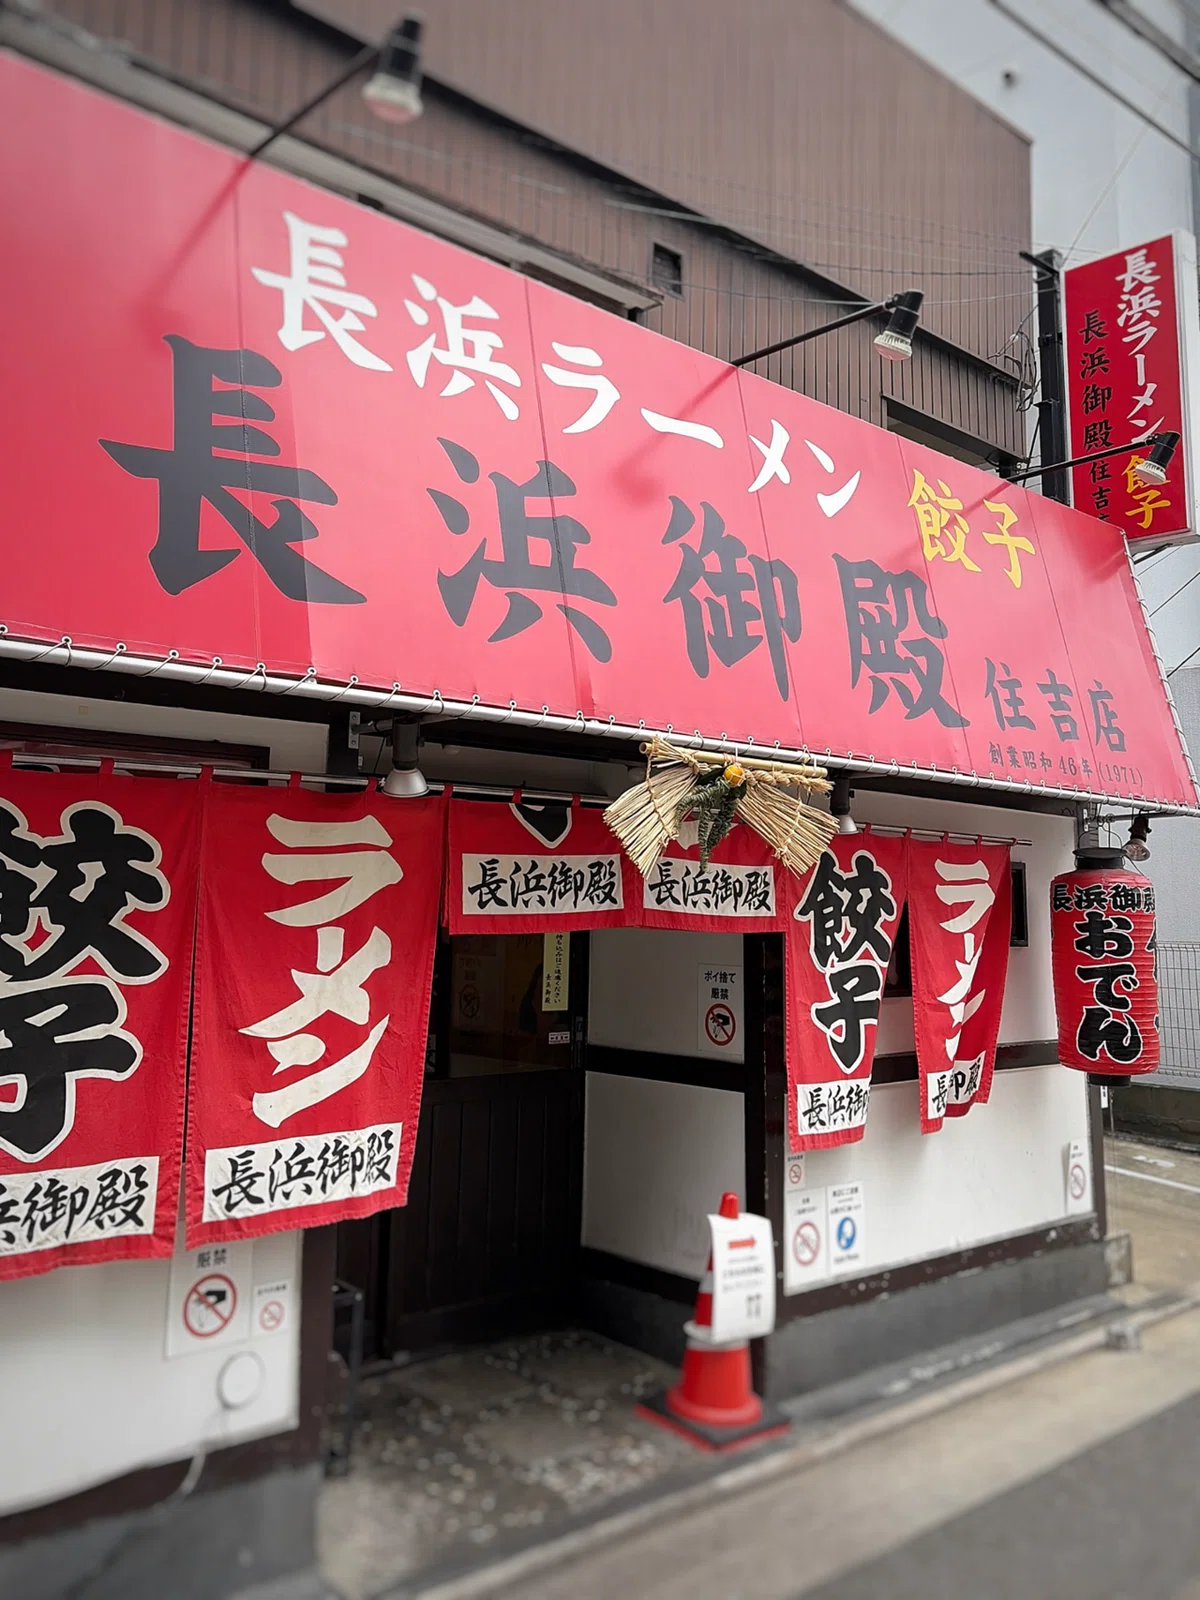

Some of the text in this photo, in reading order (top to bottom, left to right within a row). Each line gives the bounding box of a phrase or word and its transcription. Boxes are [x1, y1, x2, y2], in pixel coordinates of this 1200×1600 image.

[251, 211, 1036, 588] 長浜ラーメン 餃子
[1115, 248, 1164, 445] 長浜ラーメン
[98, 334, 971, 728] 長浜御殿
[1089, 459, 1112, 524] 住吉
[984, 656, 1127, 752] 住吉店
[467, 858, 618, 910] 長浜御殿
[648, 860, 772, 912] 長浜御殿
[238, 813, 403, 1129] ラーメン
[794, 850, 897, 1074] 餃子
[1073, 910, 1144, 1064] おでん
[802, 1084, 870, 1129] 長浜御
[212, 1130, 394, 1213] 長浜御殿
